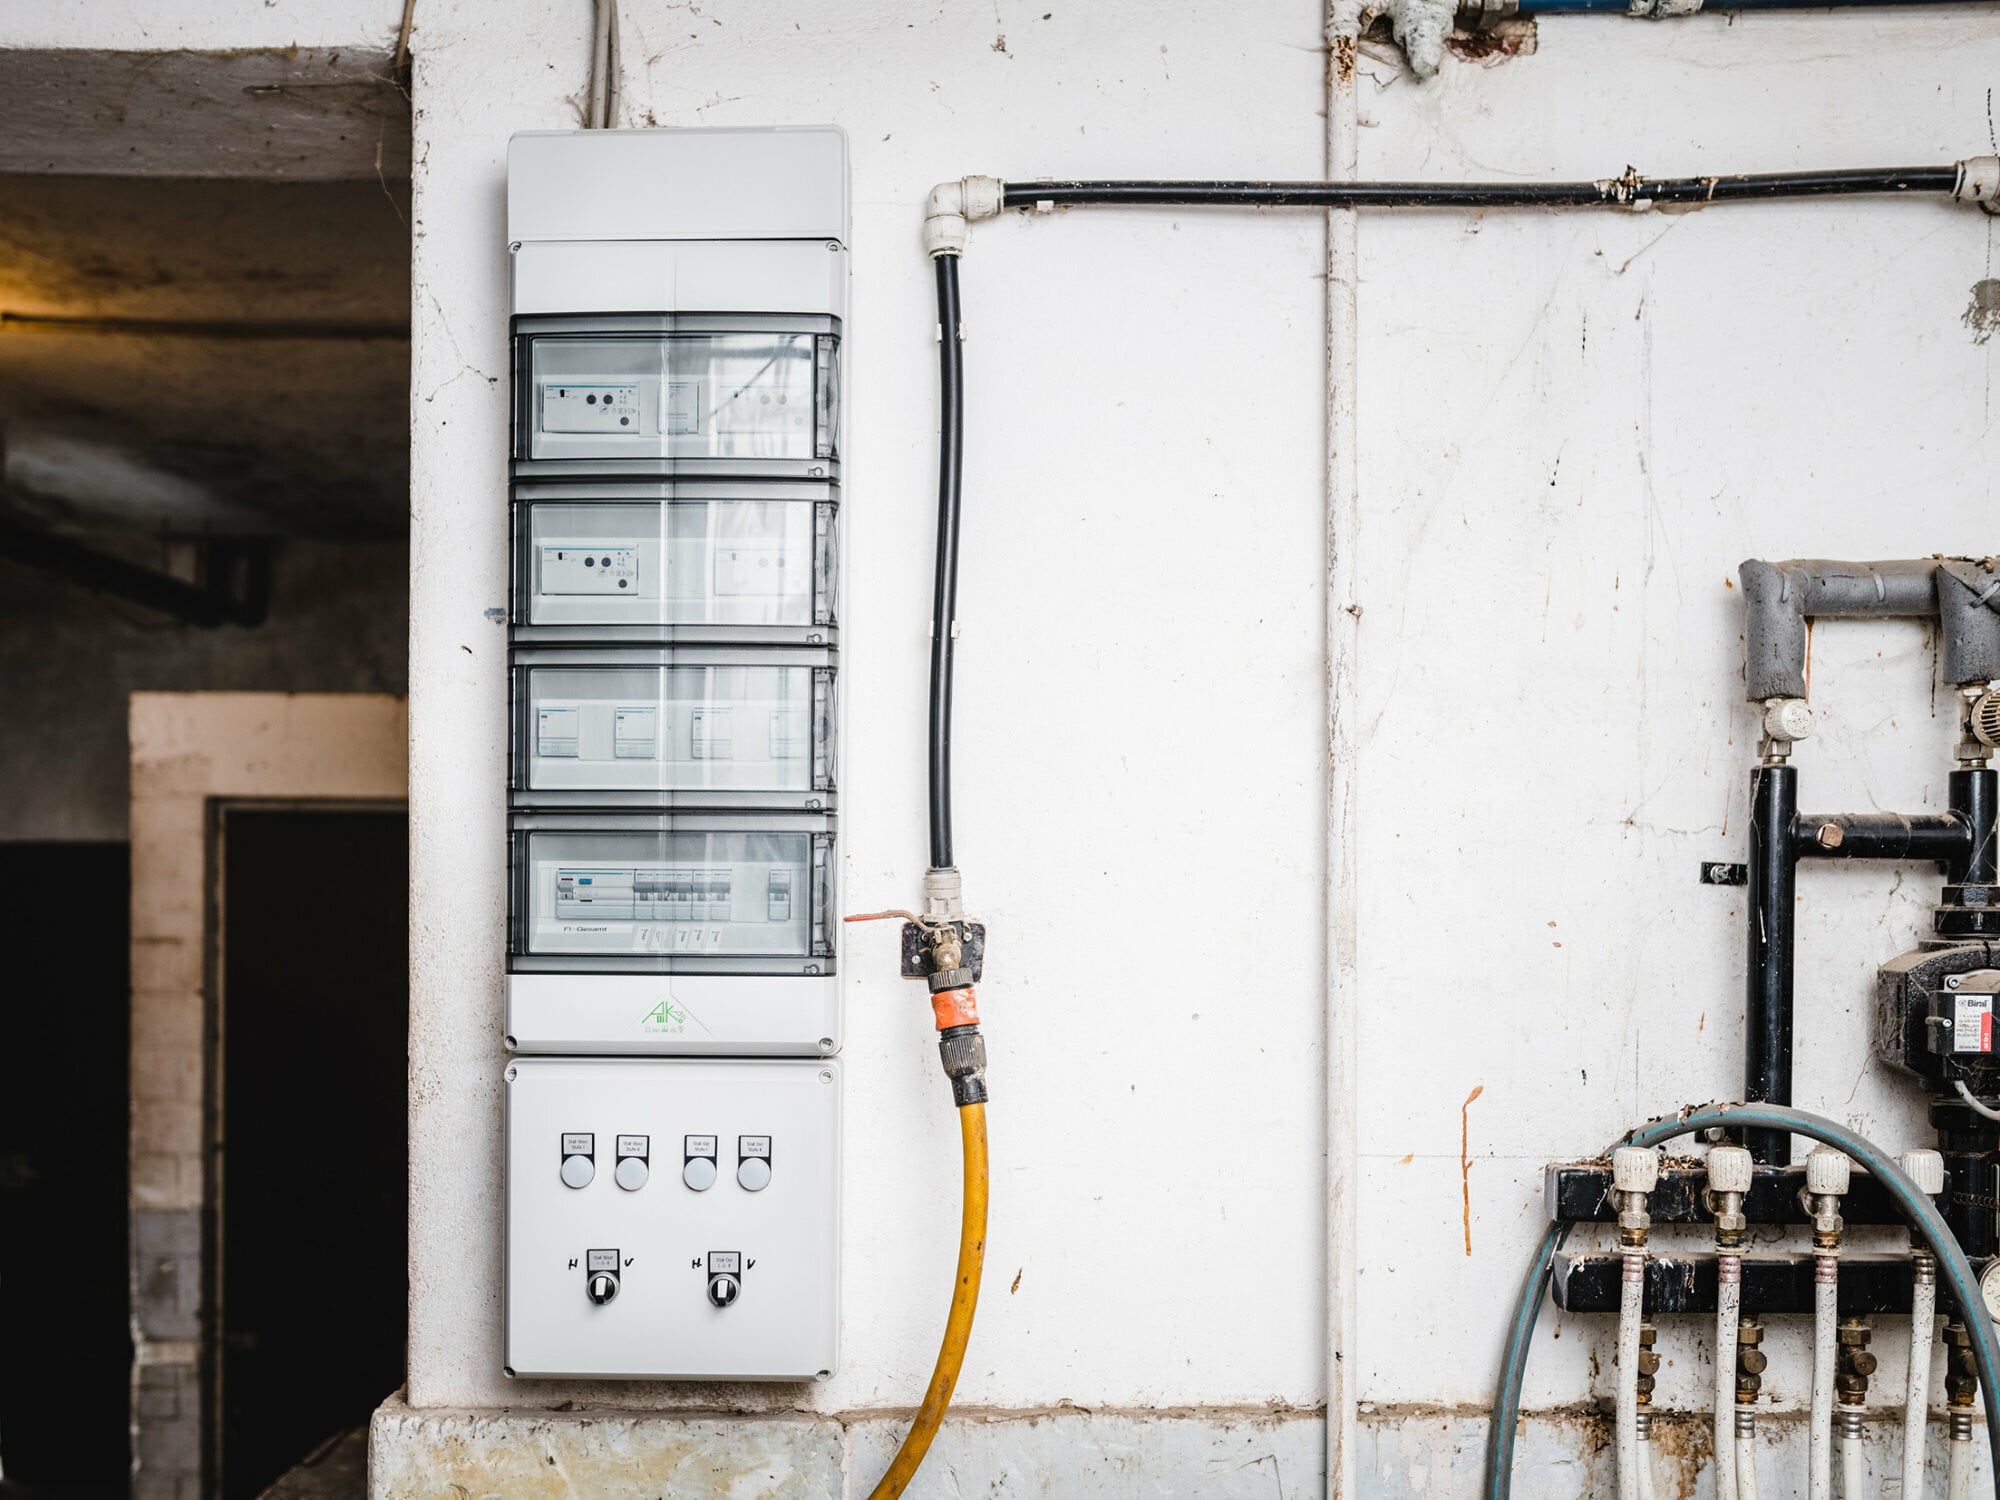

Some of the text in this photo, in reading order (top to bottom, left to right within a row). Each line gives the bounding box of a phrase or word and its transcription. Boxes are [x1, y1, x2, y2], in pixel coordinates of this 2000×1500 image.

[1967, 999, 1987, 1007] Biral
[568, 1258, 578, 1270] H
[692, 1257, 702, 1270] H
[747, 1258, 756, 1270] V
